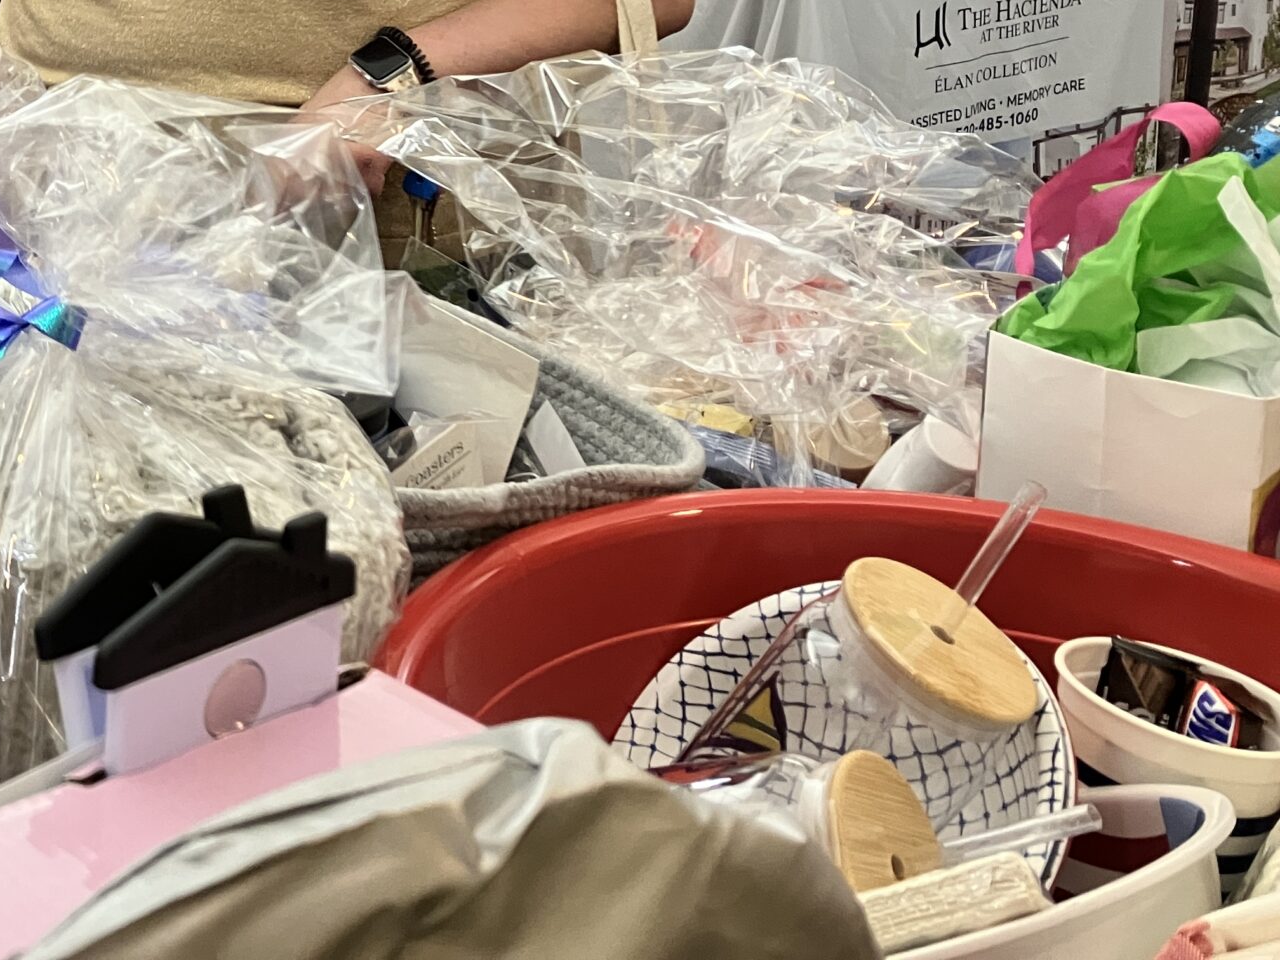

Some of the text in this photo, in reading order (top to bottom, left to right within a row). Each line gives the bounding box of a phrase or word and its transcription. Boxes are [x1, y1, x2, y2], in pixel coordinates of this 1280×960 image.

[957, 7, 992, 31] THE
[980, 14, 1060, 43] AT THE RIVER
[934, 52, 1058, 94] ÉLAN COLLECTION
[910, 78, 1086, 128] ASSISTED LIVING MEMORY CARE
[405, 441, 464, 489] Coasters
